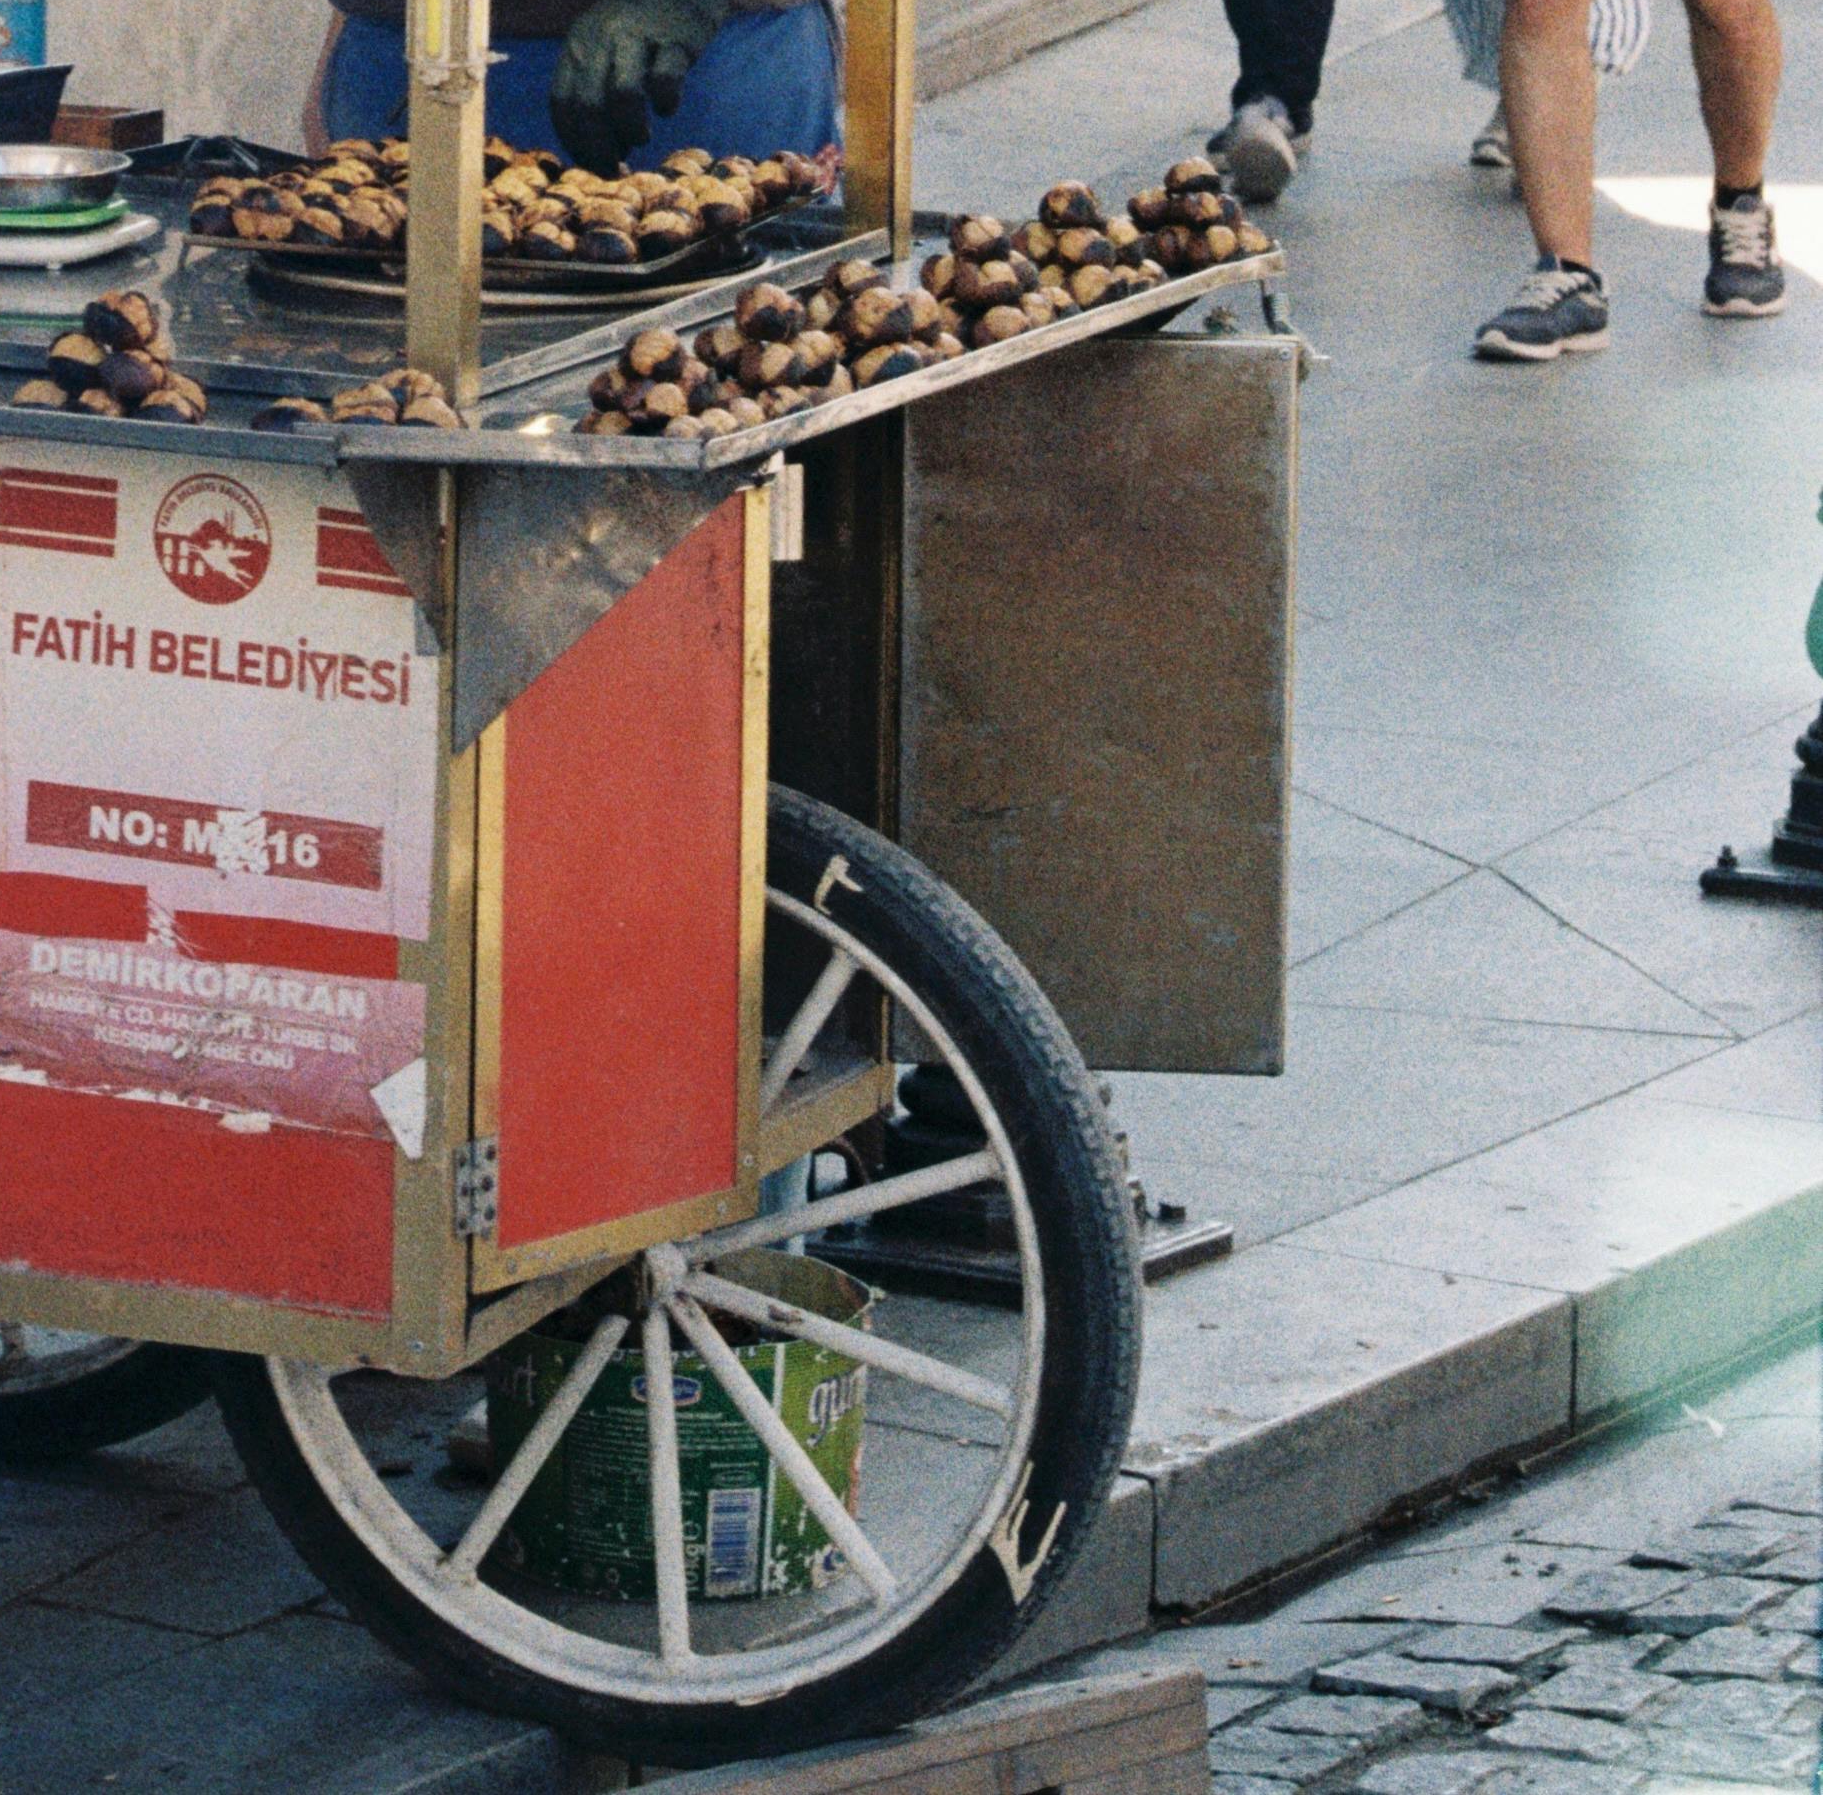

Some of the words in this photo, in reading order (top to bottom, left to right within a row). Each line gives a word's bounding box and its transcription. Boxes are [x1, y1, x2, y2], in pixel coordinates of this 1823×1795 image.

[11, 609, 137, 670] FATİH
[148, 629, 411, 707] BELEDİYESİ
[89, 805, 168, 849] NO:
